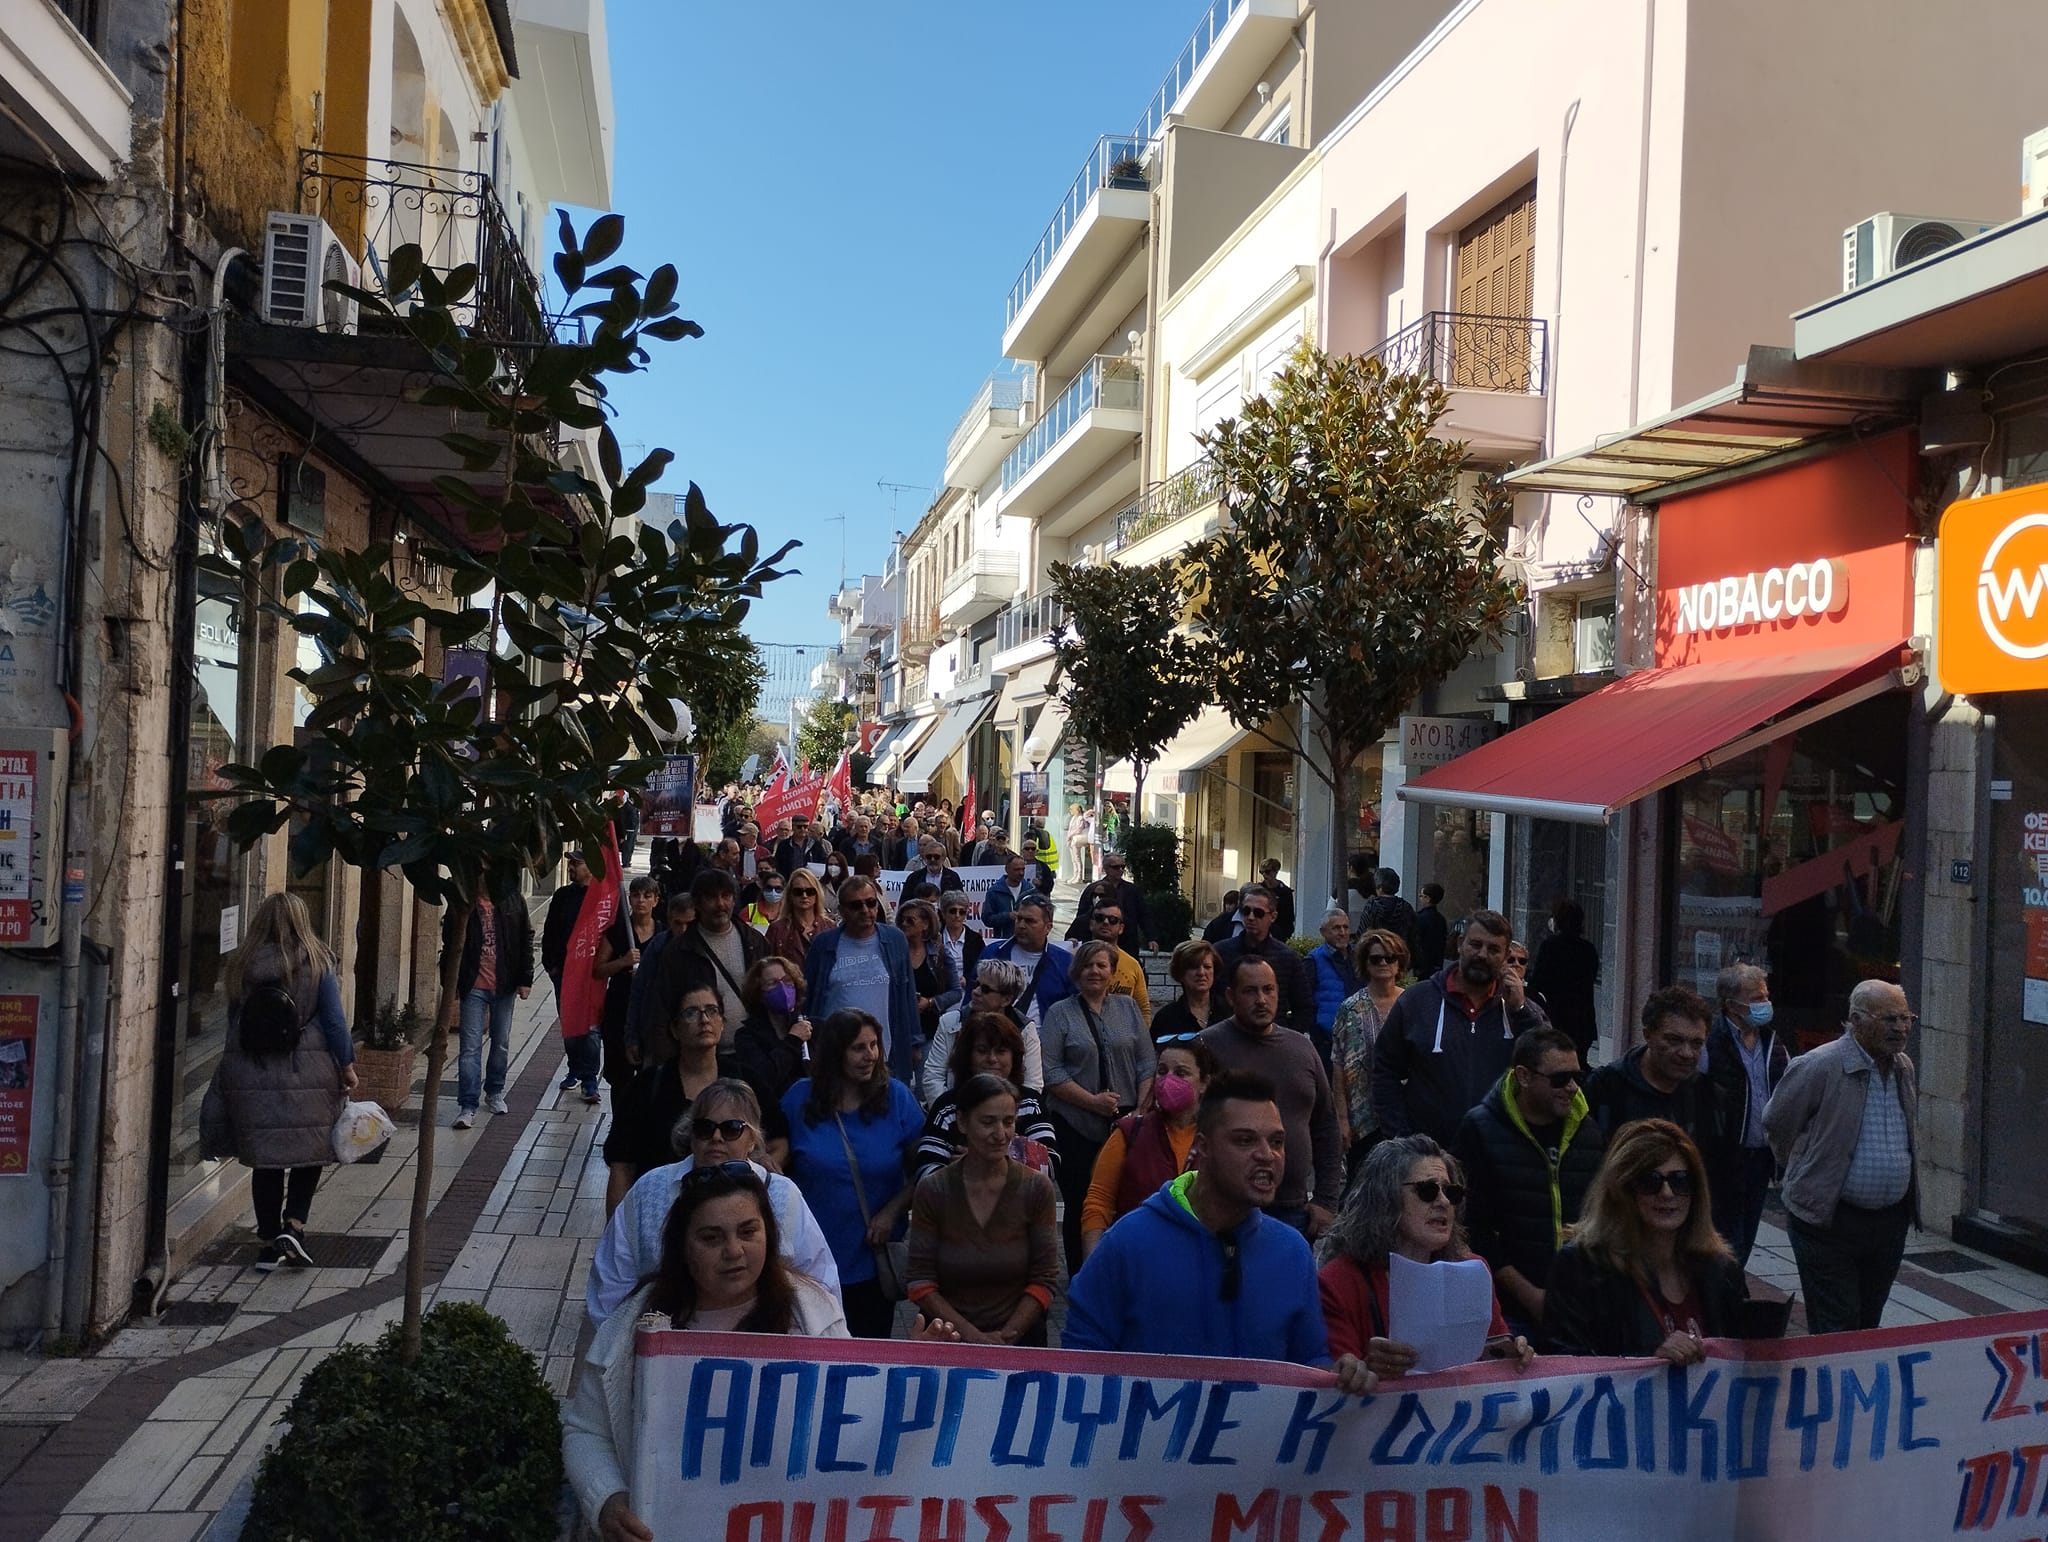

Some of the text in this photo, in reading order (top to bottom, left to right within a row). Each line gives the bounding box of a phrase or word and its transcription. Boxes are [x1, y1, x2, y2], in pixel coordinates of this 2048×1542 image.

[1677, 558, 1834, 634] NOBACCO
[1954, 864, 1969, 877] 112
[682, 1357, 1259, 1485] ΑΠΕΡΓΟΥΜΕ
[1370, 1350, 1940, 1483] ΔΙΕΚΔΙΚΟΥΜΕ
